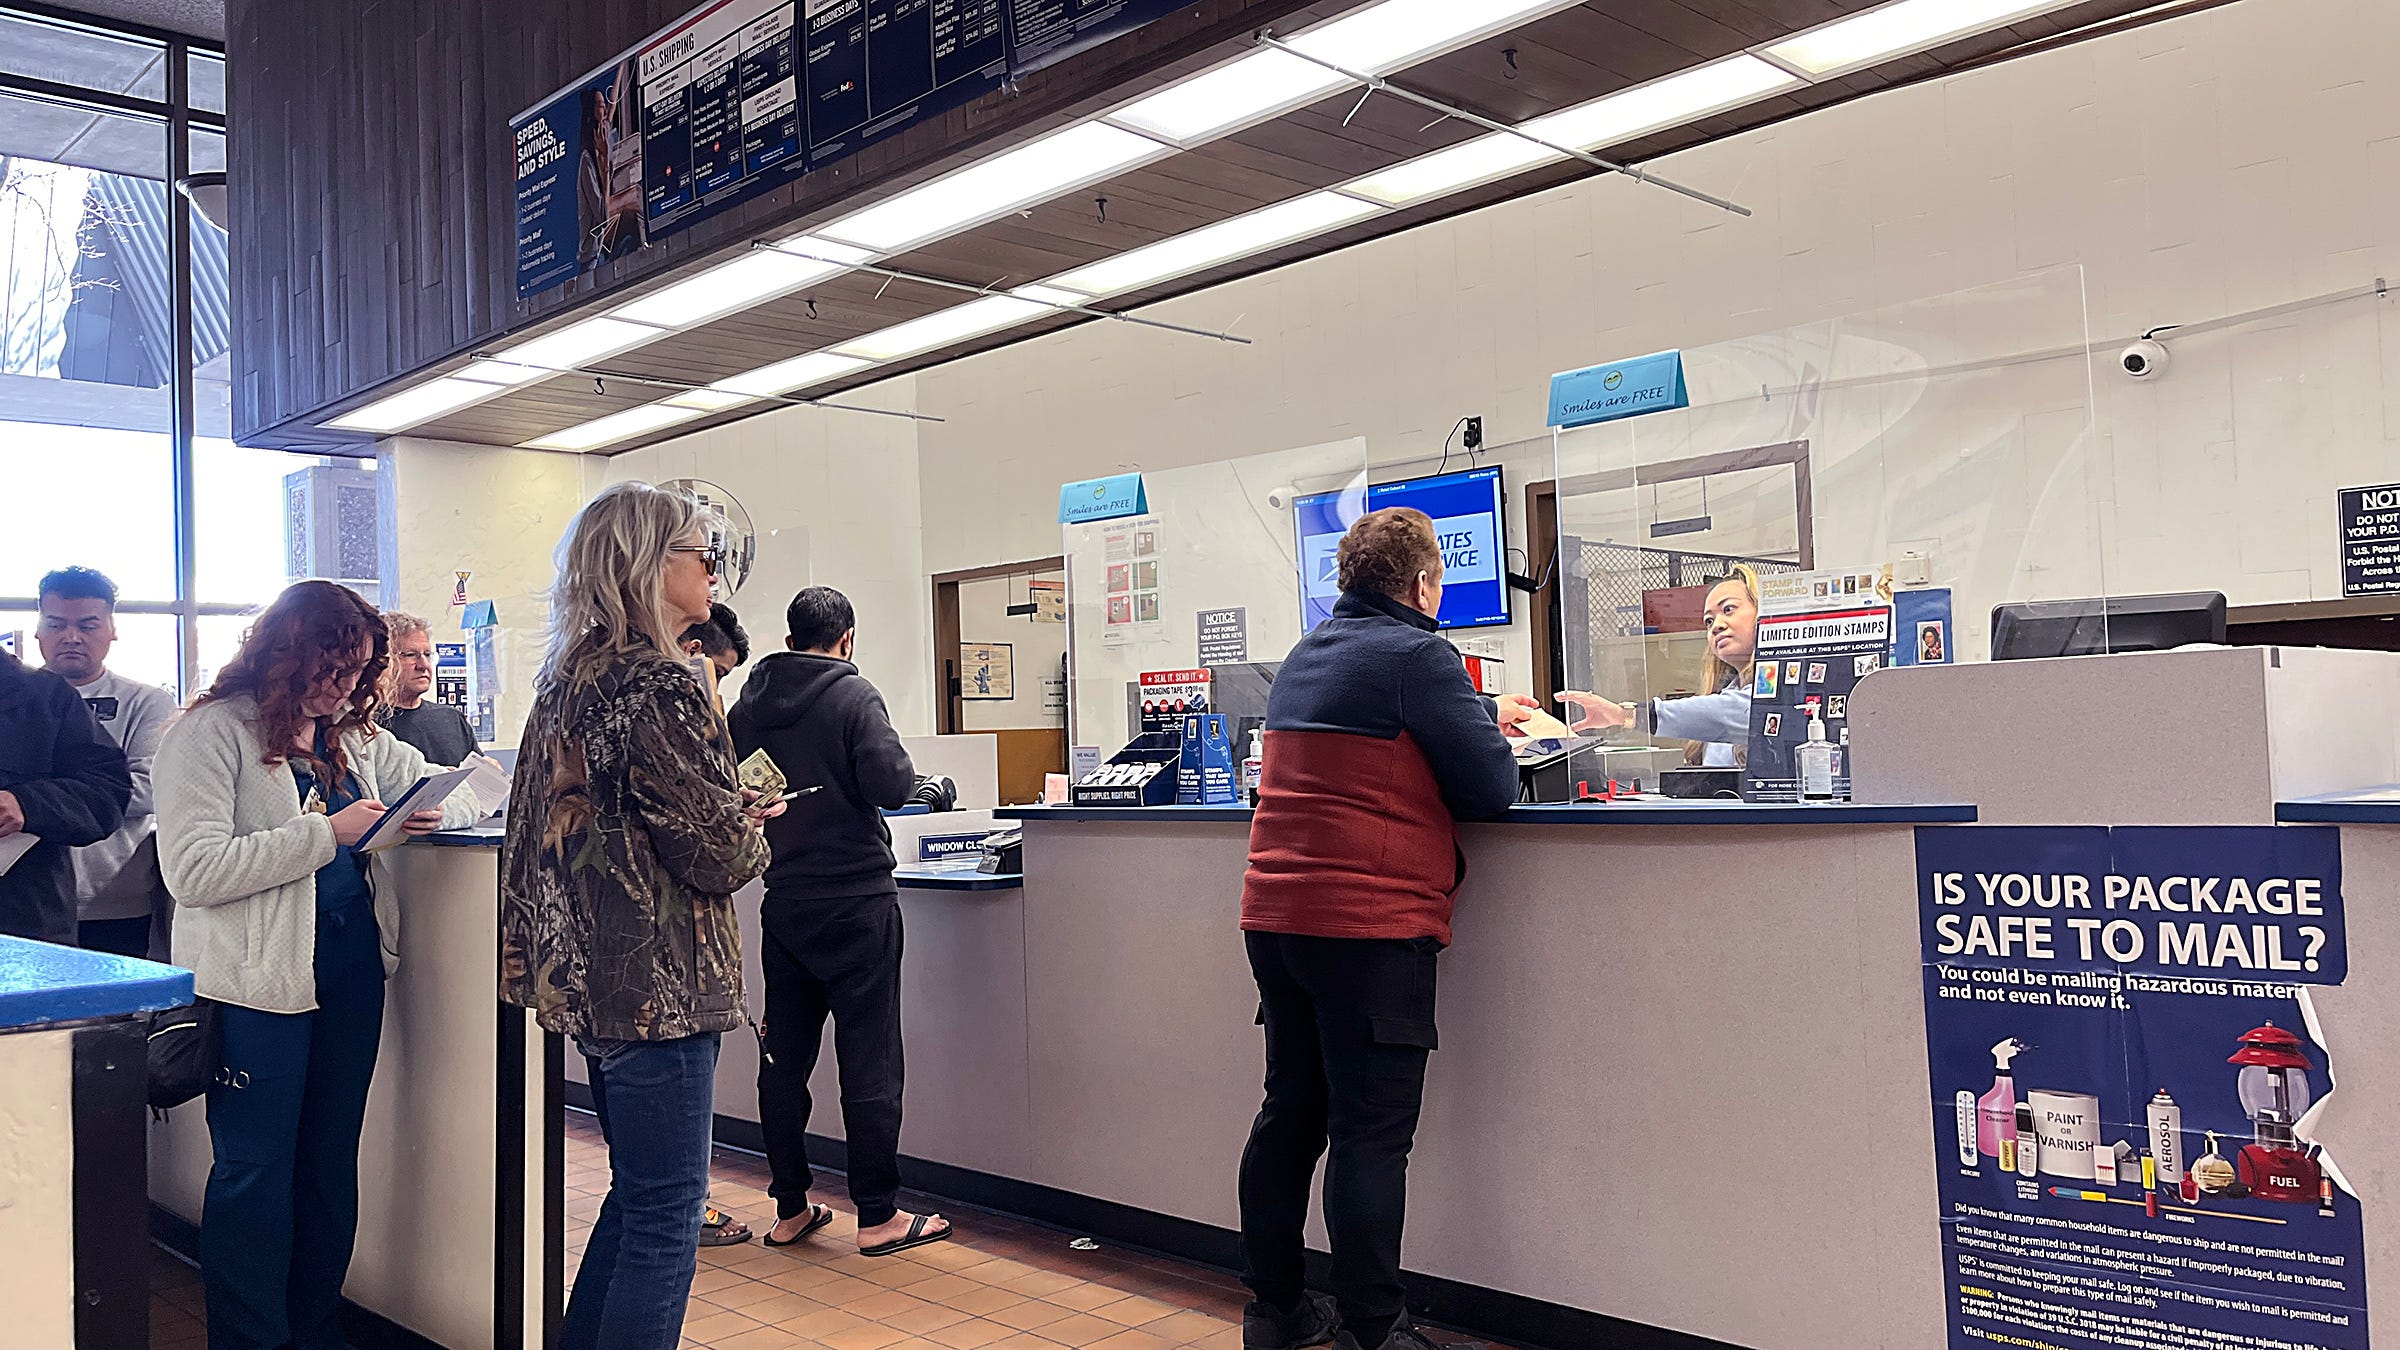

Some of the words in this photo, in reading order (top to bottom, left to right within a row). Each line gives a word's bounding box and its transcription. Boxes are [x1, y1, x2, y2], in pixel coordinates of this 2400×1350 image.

[821, 5, 845, 26] BUSINESS
[845, 0, 859, 12] DAYS
[643, 55, 658, 77] U.S.
[659, 32, 695, 67] SHIPPING
[517, 117, 548, 146] SPEED,
[518, 130, 556, 162] SAVINGS,
[518, 161, 536, 180] AND
[538, 141, 566, 169] STYLE
[1562, 399, 1604, 416] Smiles
[1606, 395, 1631, 408] are
[1631, 386, 1665, 404] FREE
[1067, 504, 1092, 516] Smiles
[1094, 504, 1109, 512] are
[1110, 498, 1130, 510] FREE
[2362, 490, 2400, 509] NOT
[2357, 515, 2373, 525] DO
[2377, 513, 2400, 524] NOT
[2347, 526, 2377, 537] YOUR
[2380, 524, 2400, 535] P.O.
[1437, 532, 1472, 550] ATES
[2353, 547, 2370, 555] U.S.
[2372, 544, 2400, 554] Postal
[1442, 550, 1479, 568] VICE
[2347, 556, 2375, 566] Forbid
[2377, 556, 2391, 564] the
[2362, 567, 2394, 576] Across
[1762, 578, 1794, 590] STAMP
[1796, 577, 1804, 586] IT
[1762, 586, 1808, 598] FORWARD
[1206, 612, 1236, 625] NOTICE
[1761, 628, 1799, 642] LIMITED
[1802, 625, 1842, 640] EDITION
[1844, 621, 1884, 636] STAMPS
[1776, 648, 1807, 656] AVAILABLE
[1154, 674, 1166, 683] SEAL
[1175, 672, 1189, 682] SEND
[1144, 687, 1170, 696] PACKAGING
[1171, 686, 1183, 695] TAPE
[1078, 792, 1090, 801] RIGHT
[1111, 791, 1123, 800] RIGHT
[1124, 790, 1136, 799] PRICE
[927, 841, 964, 853] WINDOW
[1933, 872, 1966, 905] IS
[1975, 873, 2090, 909] YOUR
[2104, 875, 2324, 916] PACKAGE
[1936, 914, 2055, 960] SAFE
[2067, 918, 2144, 963] TO
[2158, 922, 2327, 973] MAIL?
[1937, 965, 1968, 981] You
[1972, 967, 2020, 985] could
[2024, 969, 2047, 986] be
[2051, 971, 2122, 993] mailing
[2125, 974, 2228, 996] hazardous
[2232, 984, 2296, 999] mater
[1939, 984, 1971, 999] and
[1976, 988, 2005, 1001] not
[2008, 990, 2051, 1005] even
[2056, 989, 2107, 1008] know
[2111, 992, 2130, 1009] it.
[1985, 1115, 2010, 1124] Cleaner
[2047, 1111, 2084, 1126] PAINT
[2060, 1127, 2072, 1135] OR
[2040, 1134, 2095, 1152] VARNISH
[2160, 1115, 2173, 1172] AEROSOL
[2270, 1175, 2300, 1189] FUEL
[1955, 1203, 1967, 1212] Did
[1968, 1207, 1979, 1215] you
[1980, 1207, 1997, 1218] know
[1999, 1211, 2012, 1221] that
[2014, 1215, 2034, 1225] many
[2036, 1217, 2067, 1228] common
[2068, 1220, 2106, 1233] household
[2108, 1225, 2128, 1237] items
[2129, 1230, 2141, 1238] are
[2143, 1230, 2182, 1244] dangerous
[2193, 1237, 2209, 1250] ship
[2211, 1241, 2226, 1250] and
[2227, 1244, 2239, 1253] are
[2241, 1246, 2254, 1255] not
[2256, 1248, 2296, 1260] permitted
[2307, 1252, 2321, 1263] the
[2322, 1256, 2344, 1266] mail?
[1956, 1223, 1972, 1234] Even
[1973, 1227, 1992, 1238] items
[1993, 1230, 2007, 1241] that
[2008, 1235, 2019, 1243] are
[2021, 1237, 2058, 1248] permitted
[2069, 1241, 2082, 1252] the
[2083, 1245, 2100, 1254] mail
[2102, 1248, 2115, 1256] can
[2117, 1250, 2145, 1261] present
[2153, 1253, 2180, 1266] hazard
[2189, 1259, 2232, 1276] improperly
[2234, 1267, 2275, 1281] packaged,
[2277, 1272, 2293, 1282] due
[2305, 1276, 2345, 1291] vibration,
[1957, 1235, 1997, 1250] temperature
[1998, 1240, 2029, 1256] changes,
[2030, 1248, 2044, 1257] and
[2046, 1251, 2082, 1263] variations
[2092, 1257, 2139, 1271] atmospheric
[2140, 1265, 2174, 1277] pressure.
[1963, 1325, 1985, 1339] Visit
